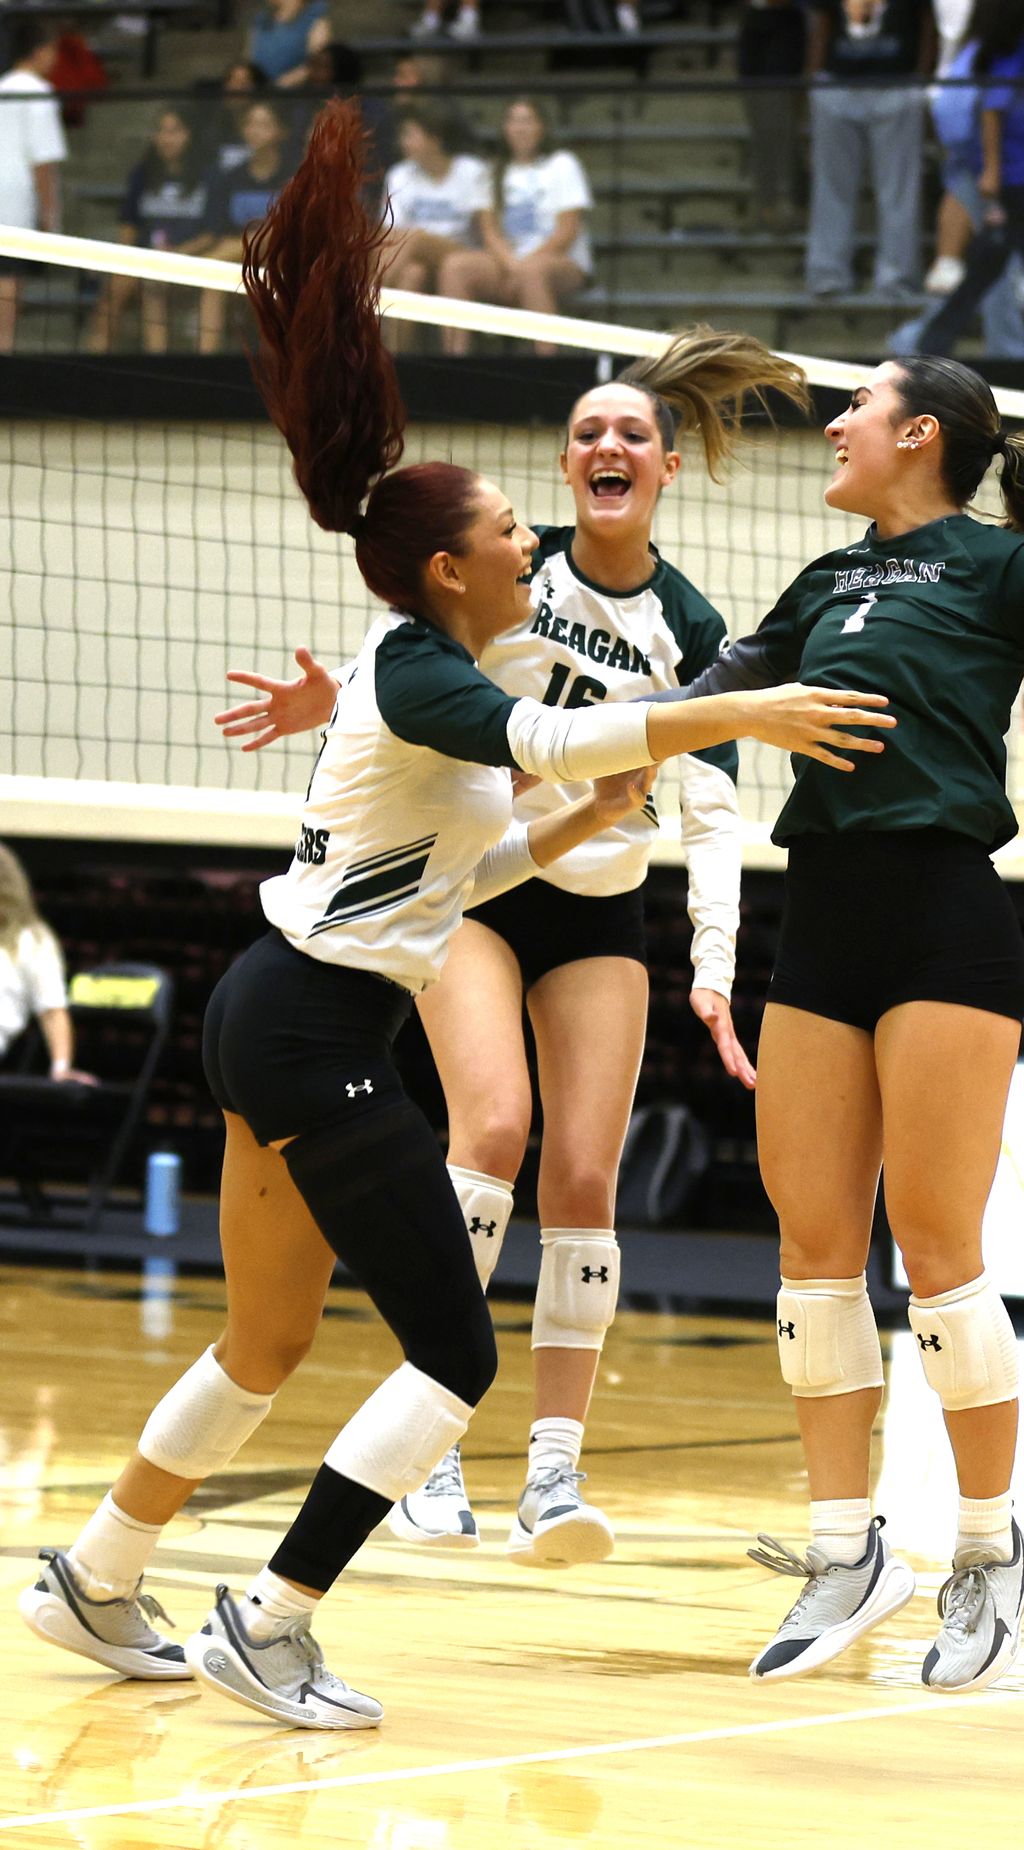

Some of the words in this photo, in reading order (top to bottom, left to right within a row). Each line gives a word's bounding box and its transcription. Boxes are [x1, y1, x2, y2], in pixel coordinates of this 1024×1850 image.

[841, 592, 878, 633] 1
[530, 602, 652, 677] REAGAN
[541, 662, 607, 709] 16
